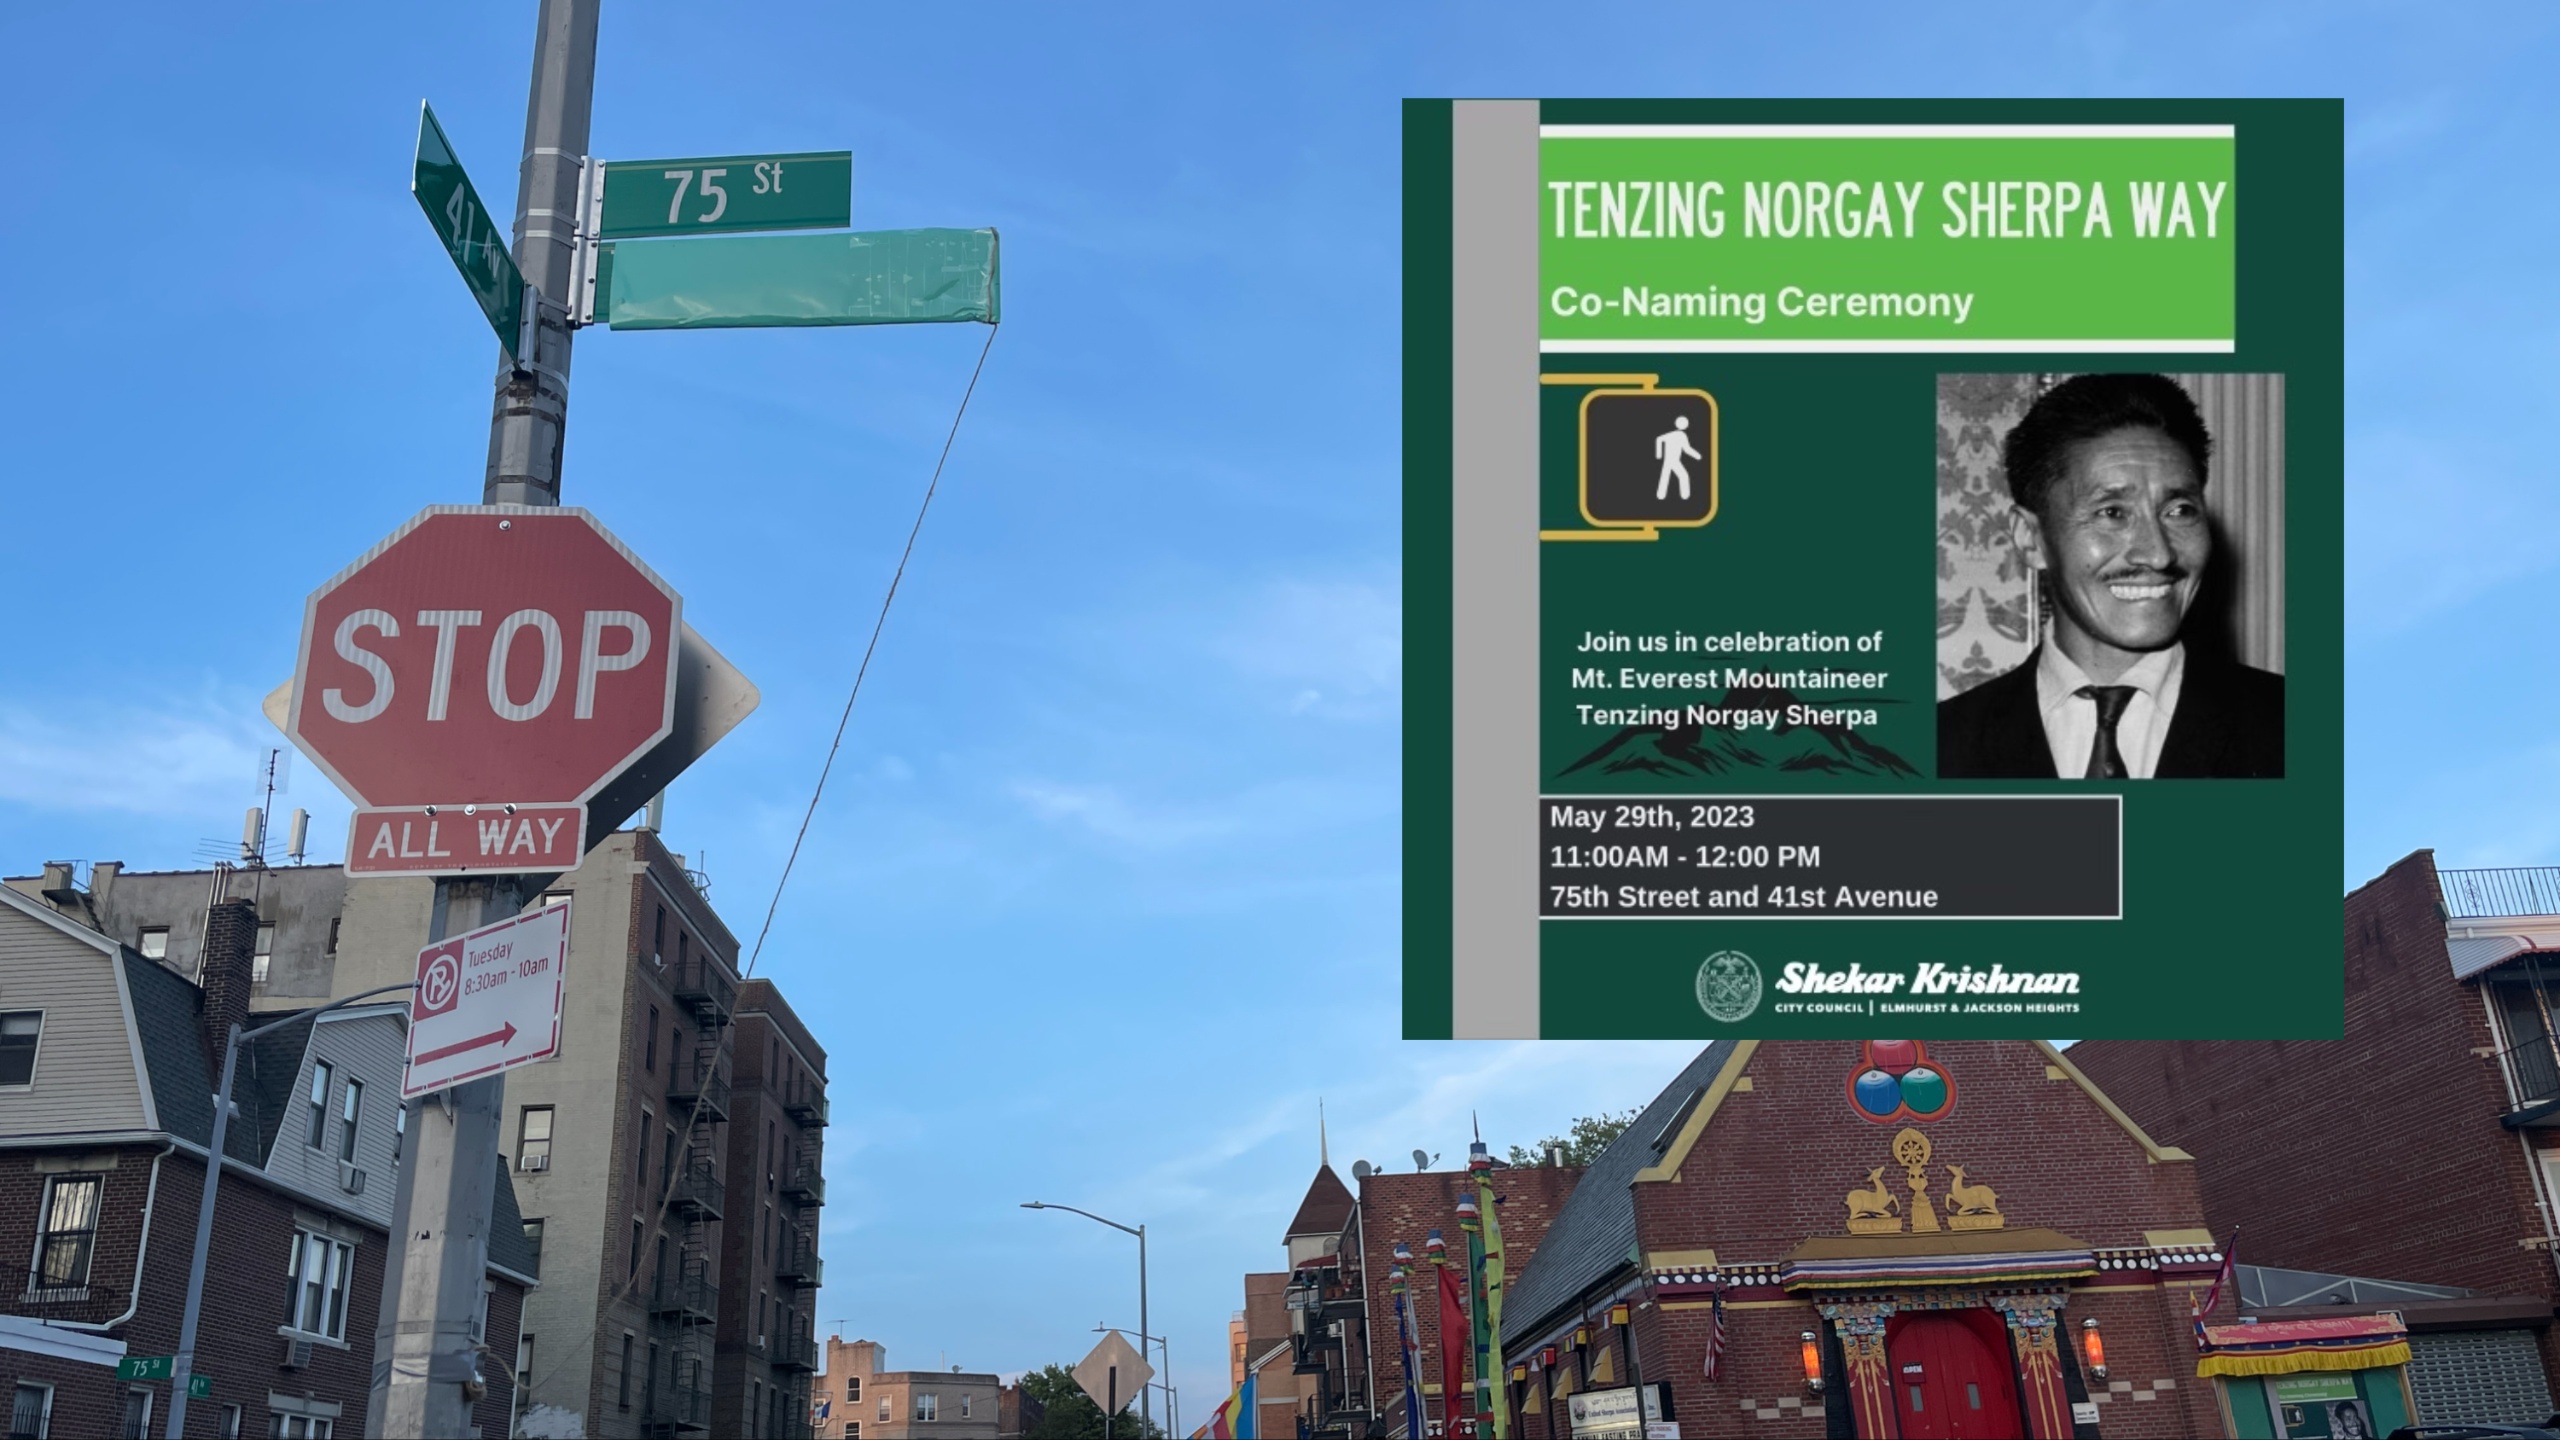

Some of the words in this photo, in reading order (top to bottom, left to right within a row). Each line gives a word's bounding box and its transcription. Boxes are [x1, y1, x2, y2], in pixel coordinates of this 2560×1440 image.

[664, 168, 727, 224] 75
[753, 161, 783, 194] St
[446, 182, 475, 265] 41
[483, 228, 500, 279] Av
[322, 609, 652, 723] STOP
[367, 821, 450, 859] ALL
[478, 818, 566, 856] WAY
[469, 941, 513, 968] Tuesday
[464, 971, 507, 995] 8:30am
[519, 957, 548, 978] 10am
[133, 1361, 148, 1376] 75
[152, 1359, 160, 1369] St
[191, 1379, 199, 1395] 41
